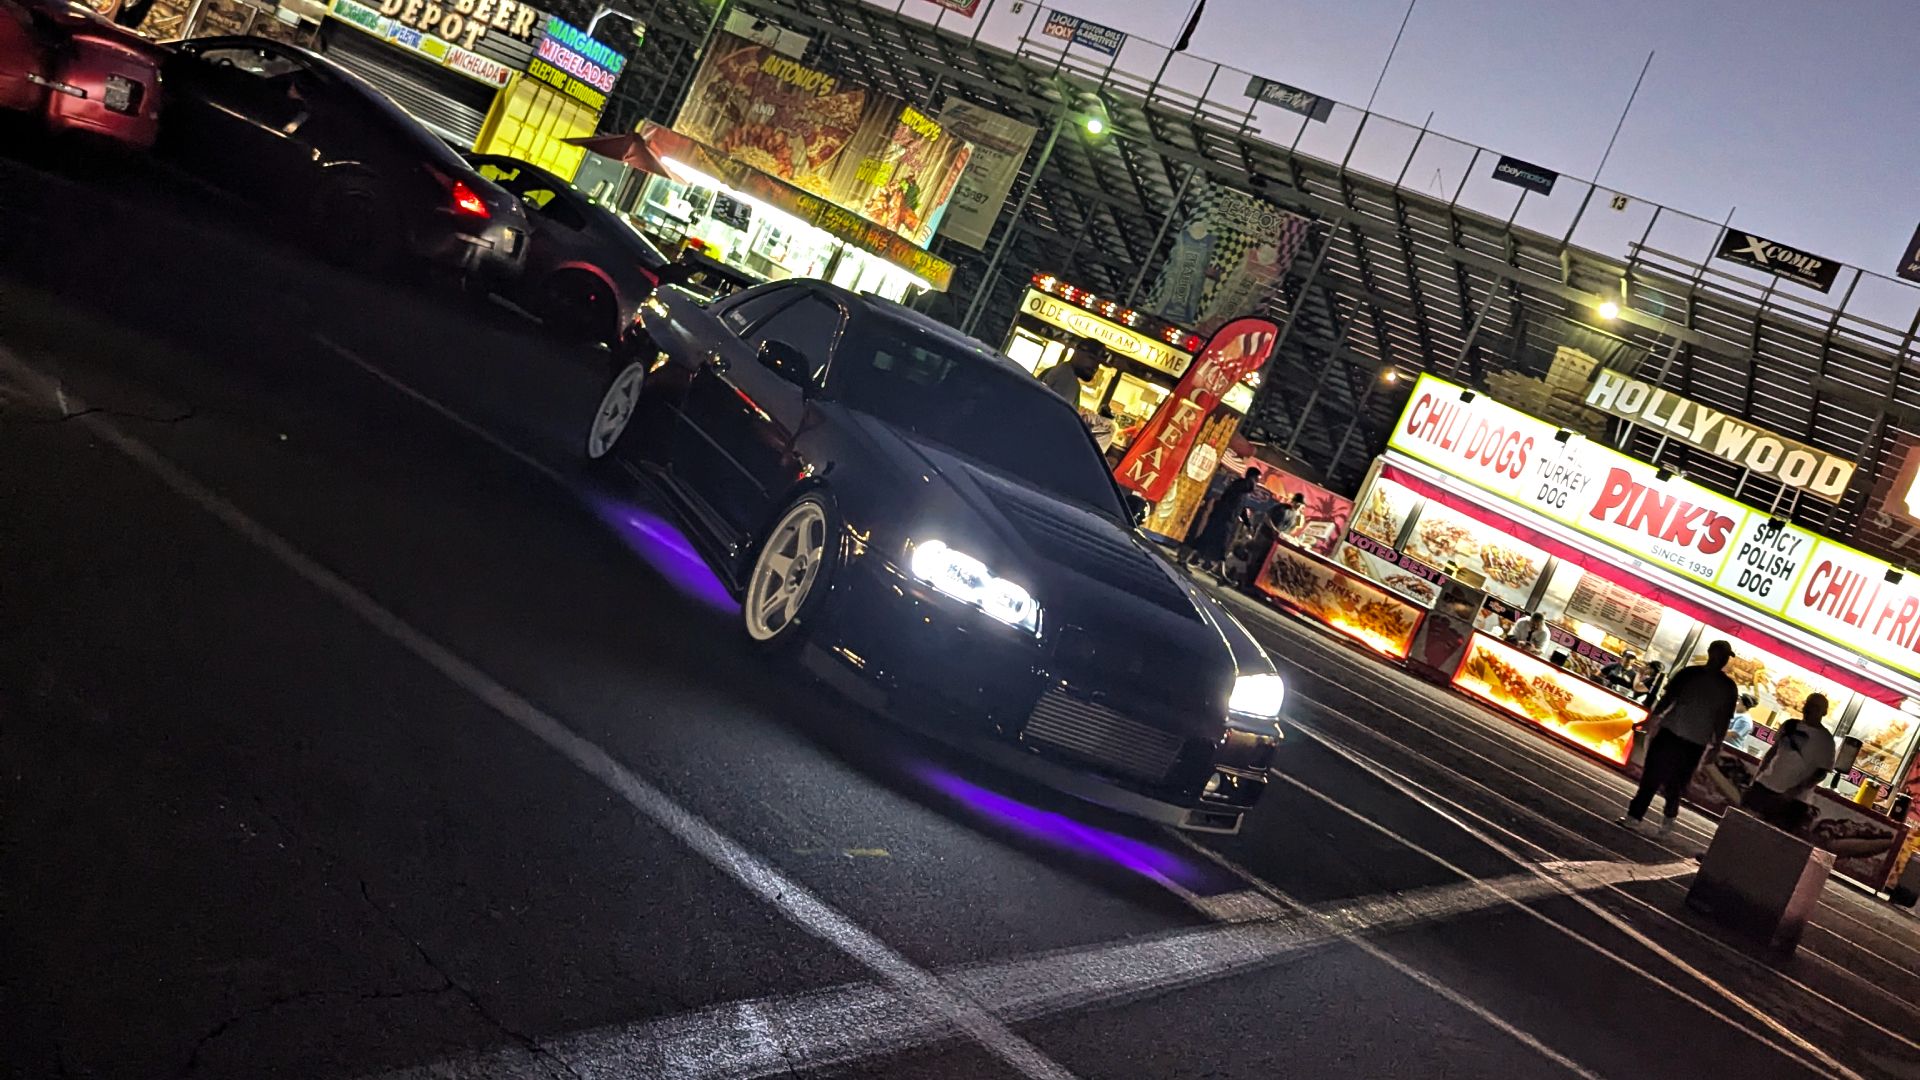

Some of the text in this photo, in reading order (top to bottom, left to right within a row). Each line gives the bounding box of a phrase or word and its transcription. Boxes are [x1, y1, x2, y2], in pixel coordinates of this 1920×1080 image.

[379, 0, 486, 50] DEPOT
[454, 0, 536, 38] BEER
[1045, 22, 1075, 38] MOLY
[1050, 12, 1080, 28] LIQUI
[1080, 22, 1121, 40] MOTOR OILS
[547, 16, 624, 73] MARGARITAS
[453, 51, 499, 85] MICHELADA
[528, 58, 568, 89] ELECTRIC
[538, 38, 615, 92] MICHELADAS
[760, 55, 835, 96] ANTONIO'S
[899, 106, 942, 142] ANTONIO'S
[1218, 197, 1281, 232] BEATBOX
[1612, 195, 1628, 210] 13
[1030, 297, 1184, 372] OLDE ICE CREAM TYME
[1407, 393, 1473, 453] CHILI
[1464, 420, 1534, 480] DOGS
[1588, 372, 1856, 499] HOLLYWOOD
[1537, 457, 1591, 493] TURKEY
[1537, 482, 1567, 510] DOG
[1589, 467, 1736, 555] PINK'S
[1753, 522, 1803, 556] SPICY
[1350, 532, 1398, 564] VOTED
[1400, 555, 1438, 585] BEST
[1651, 545, 1714, 577] SINCE 1939
[1737, 545, 1796, 582] POLISH
[1325, 579, 1363, 604] PINK'S
[1737, 569, 1772, 598] DOG
[1803, 560, 1920, 655] CHILI FRI
[1532, 675, 1574, 702] PINK'S
